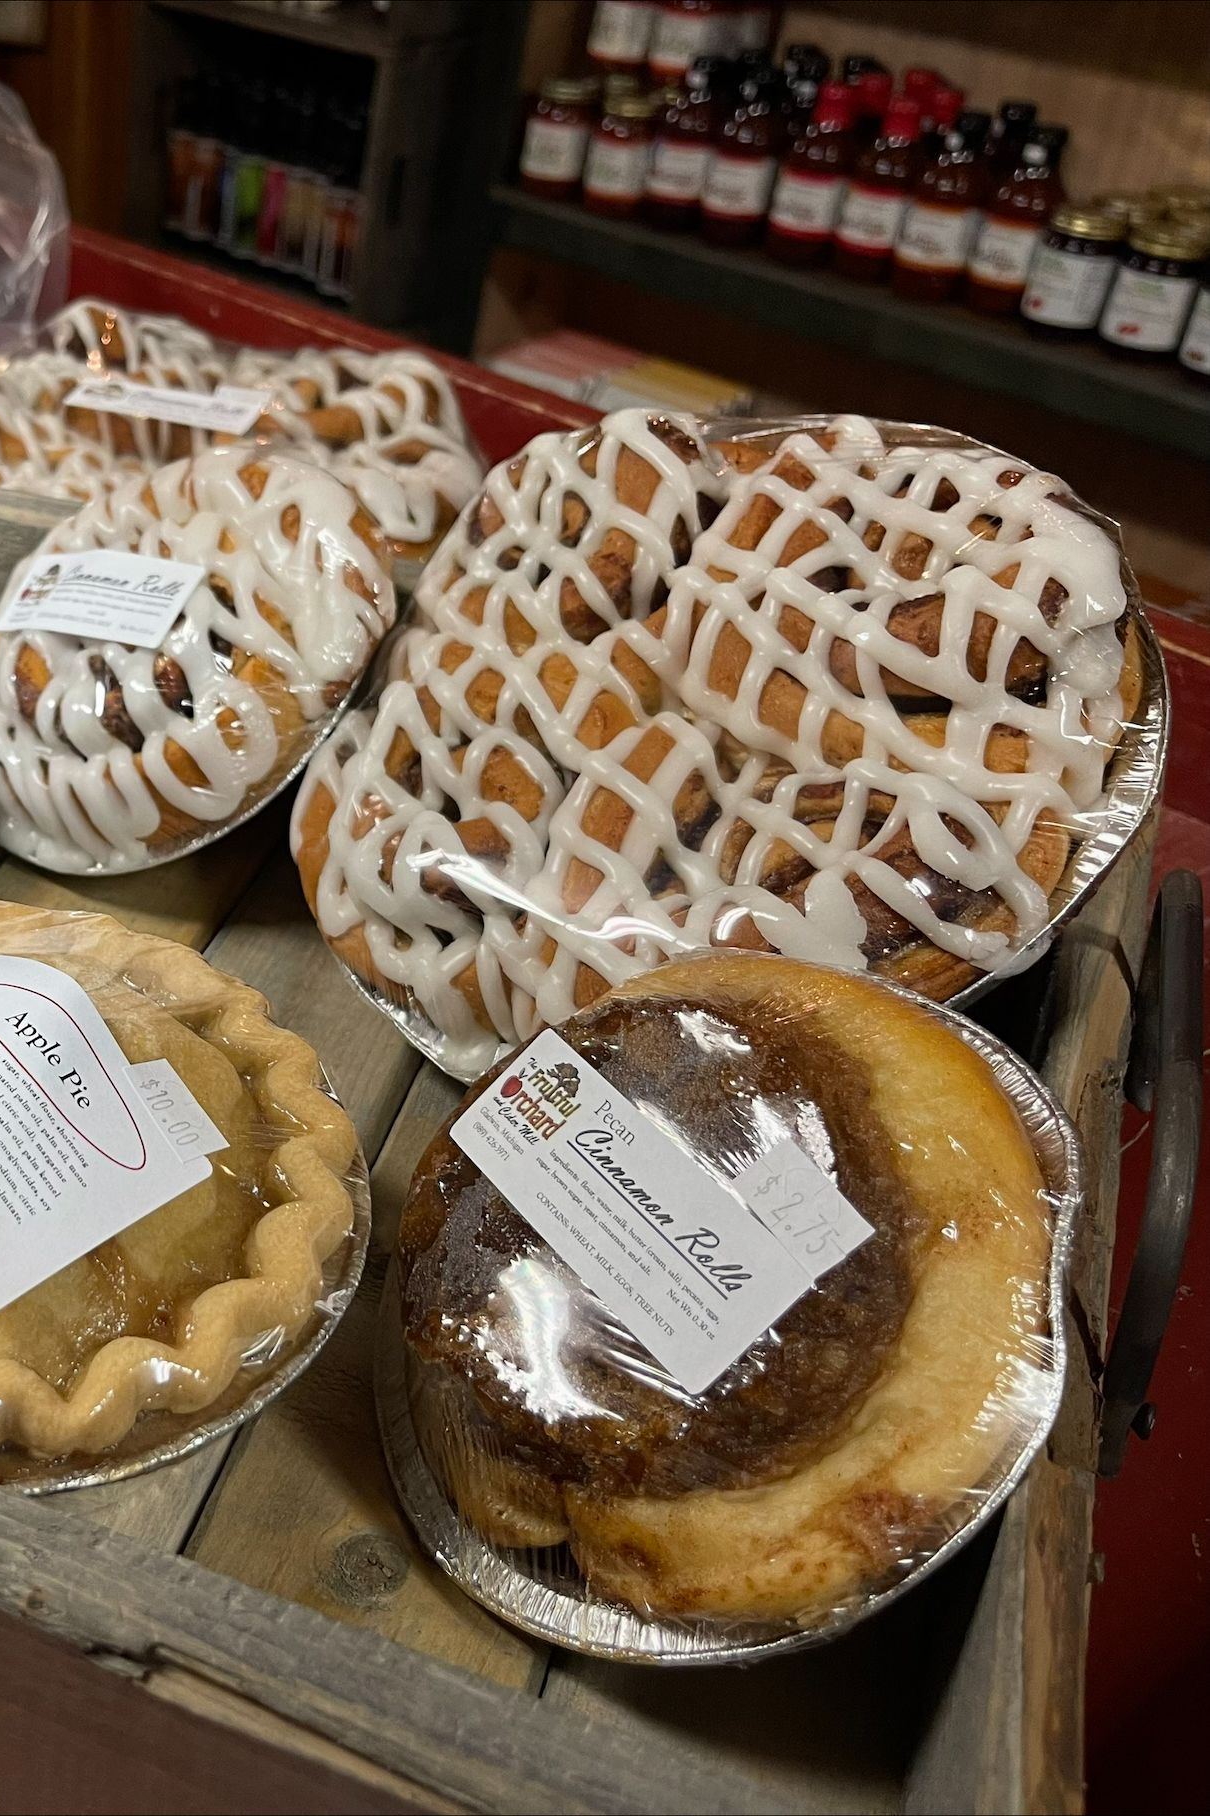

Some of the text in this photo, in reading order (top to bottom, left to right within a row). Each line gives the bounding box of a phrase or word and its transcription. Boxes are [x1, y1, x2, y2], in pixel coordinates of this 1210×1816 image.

[133, 574, 185, 596] Rolls
[4, 1011, 90, 1109] Apple Pie
[527, 1057, 538, 1070] The
[139, 1078, 200, 1146] $10.00
[493, 1096, 540, 1146] and Cider Mill
[500, 1075, 567, 1141] Orchard
[528, 1068, 582, 1118] Fruitful
[2, 1100, 19, 1119] citric
[18, 1121, 36, 1142] acid),
[36, 1143, 67, 1183] margarine
[13, 1093, 31, 1112] palm
[40, 1128, 57, 1148] palm
[69, 1164, 87, 1188] mono
[21, 1079, 40, 1101] wheat
[39, 1102, 55, 1125] flour,
[56, 1126, 89, 1168] shortening
[500, 1128, 524, 1155] Michigan
[594, 1099, 636, 1147] Pecan
[21, 1150, 39, 1171] palm
[39, 1170, 61, 1198] kernel
[18, 1194, 36, 1216] citric
[40, 1198, 51, 1211] soy
[551, 1170, 568, 1191] brown
[598, 1221, 626, 1253] cinnamon,
[627, 1251, 642, 1264] and
[575, 1129, 753, 1292] Cinnamon Rolls
[580, 1180, 595, 1199] flour,
[612, 1214, 627, 1232] milk,
[628, 1227, 647, 1248] butter
[646, 1246, 666, 1271] (cream,
[667, 1270, 682, 1286] salt),
[681, 1285, 704, 1309] pecans,
[570, 1225, 596, 1256] WHEAT,
[594, 1252, 614, 1276] MILK,
[613, 1272, 634, 1297] EGGS,
[634, 1293, 655, 1316] TREE
[651, 1312, 675, 1336] NUTS
[666, 1288, 680, 1304] Net
[692, 1315, 708, 1331] 0.30
[706, 1331, 715, 1340] oz
